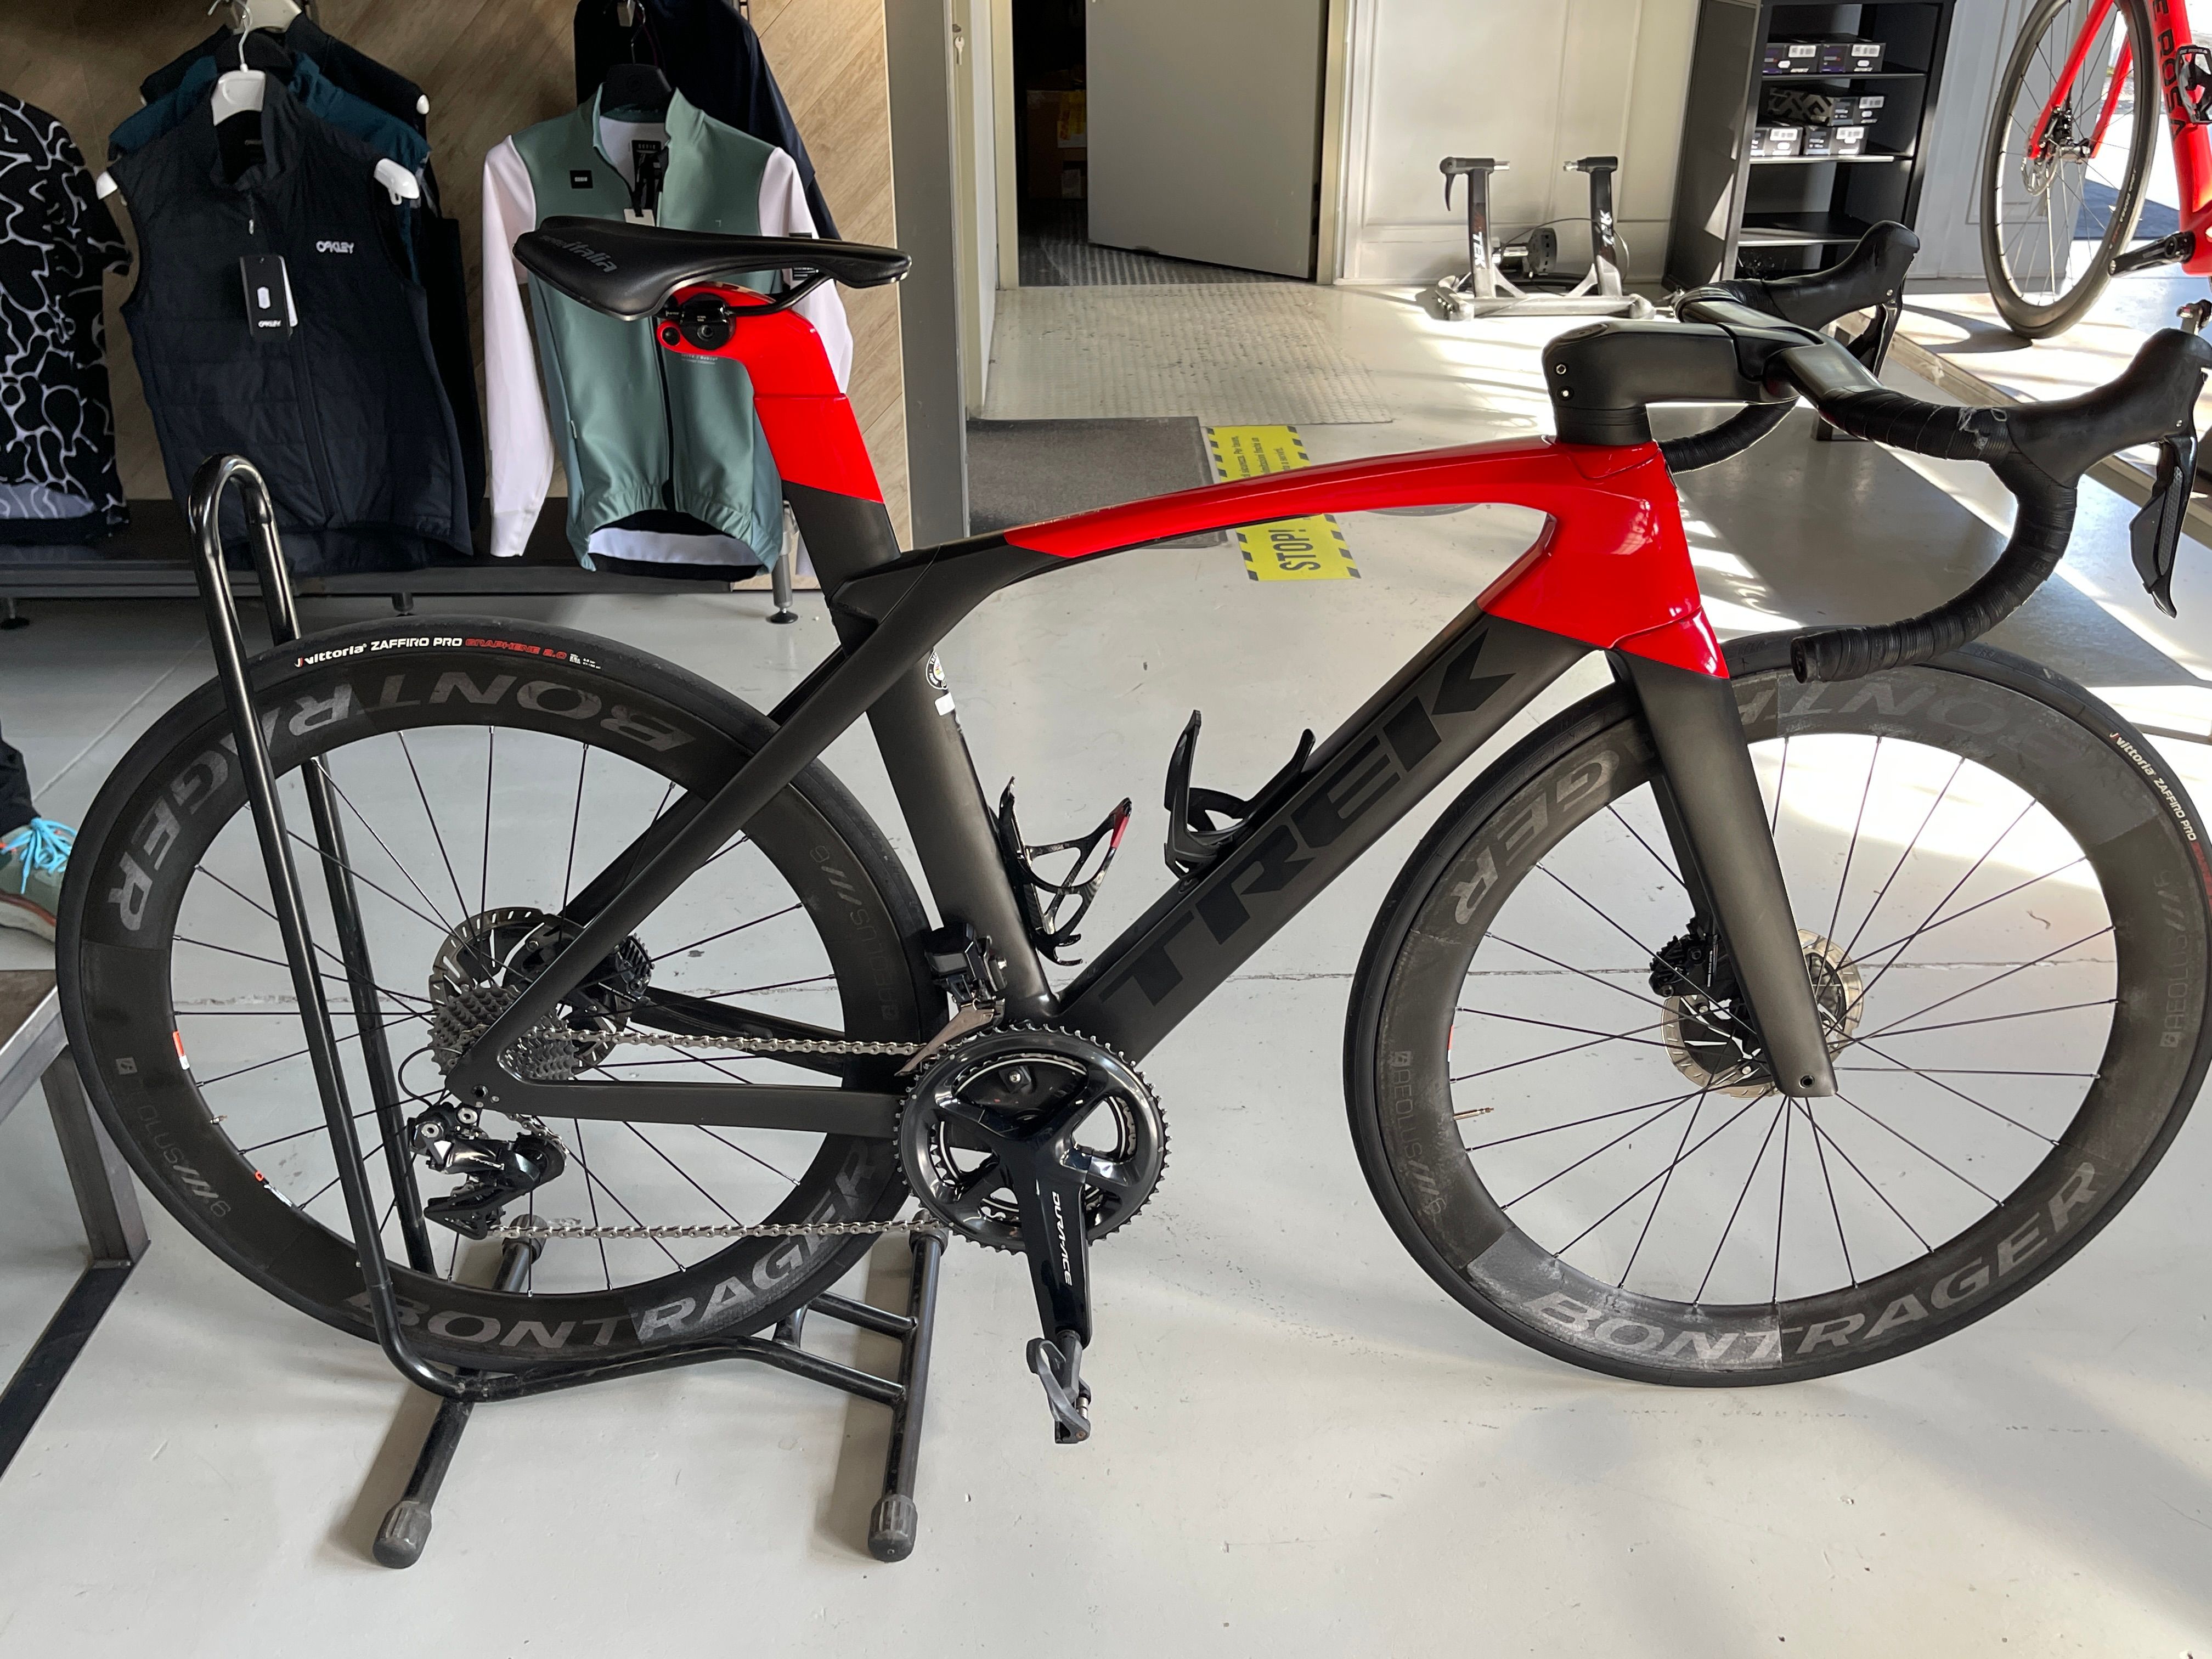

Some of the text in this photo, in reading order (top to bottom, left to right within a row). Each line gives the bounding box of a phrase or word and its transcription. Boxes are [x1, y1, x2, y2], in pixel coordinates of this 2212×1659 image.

[316, 240, 354, 253] OAKLEY
[562, 241, 618, 273] italia
[1268, 529, 1321, 571] STOP!
[371, 637, 430, 651] ZAFFIRO
[433, 637, 462, 647] PRO
[465, 638, 541, 654] GRAPHENE
[543, 648, 567, 660] 2.0
[1101, 628, 1516, 1006] TREK
[2154, 778, 2186, 821] ZAFFIRO
[2181, 819, 2197, 842] PRO
[346, 1138, 877, 1350] BONTRAGER
[1052, 1191, 1073, 1286] DURA-ACE
[1525, 1162, 2098, 1360] BONTRAGER
